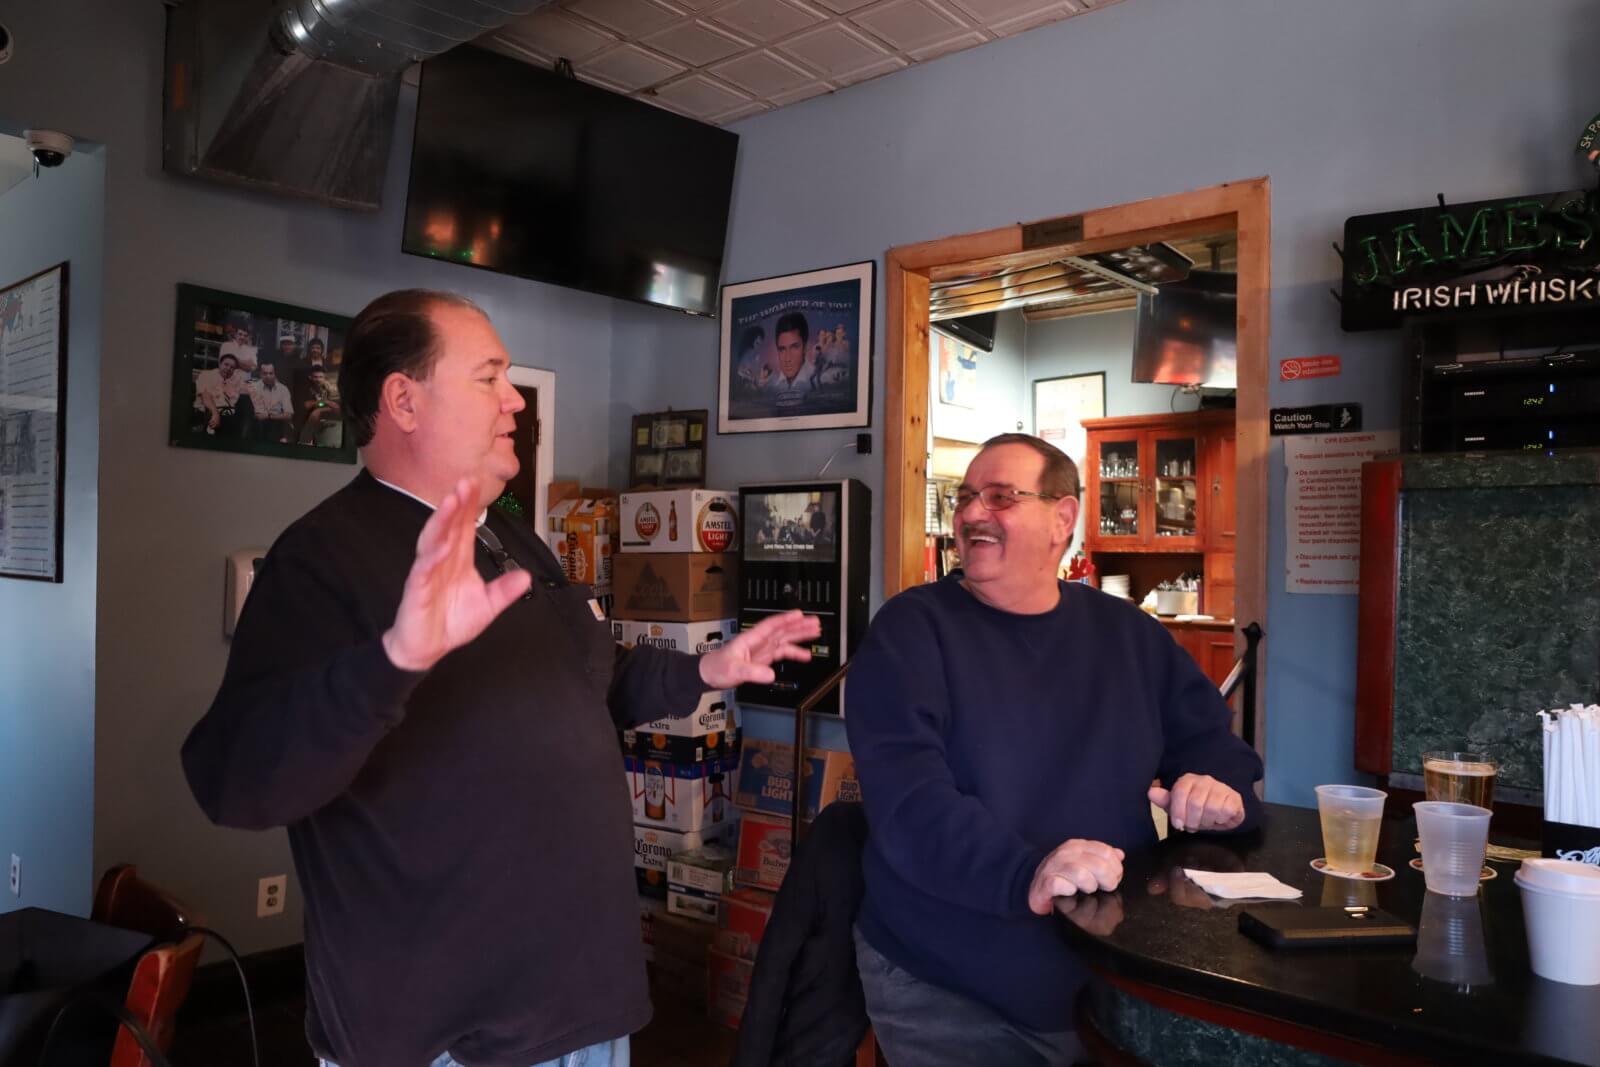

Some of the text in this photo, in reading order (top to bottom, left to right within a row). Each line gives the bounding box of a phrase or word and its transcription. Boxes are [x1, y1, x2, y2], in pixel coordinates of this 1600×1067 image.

[1393, 277, 1600, 310] IRISH WHISK
[1273, 413, 1312, 423] Caution
[1274, 422, 1296, 430] Watch
[1297, 421, 1313, 429] Your
[705, 520, 732, 531] AMSTEL
[707, 532, 729, 541] LIGHT
[699, 712, 725, 726] Corona
[767, 775, 792, 790] BUD
[761, 785, 794, 801] LIGHT
[634, 838, 673, 858] Corona
